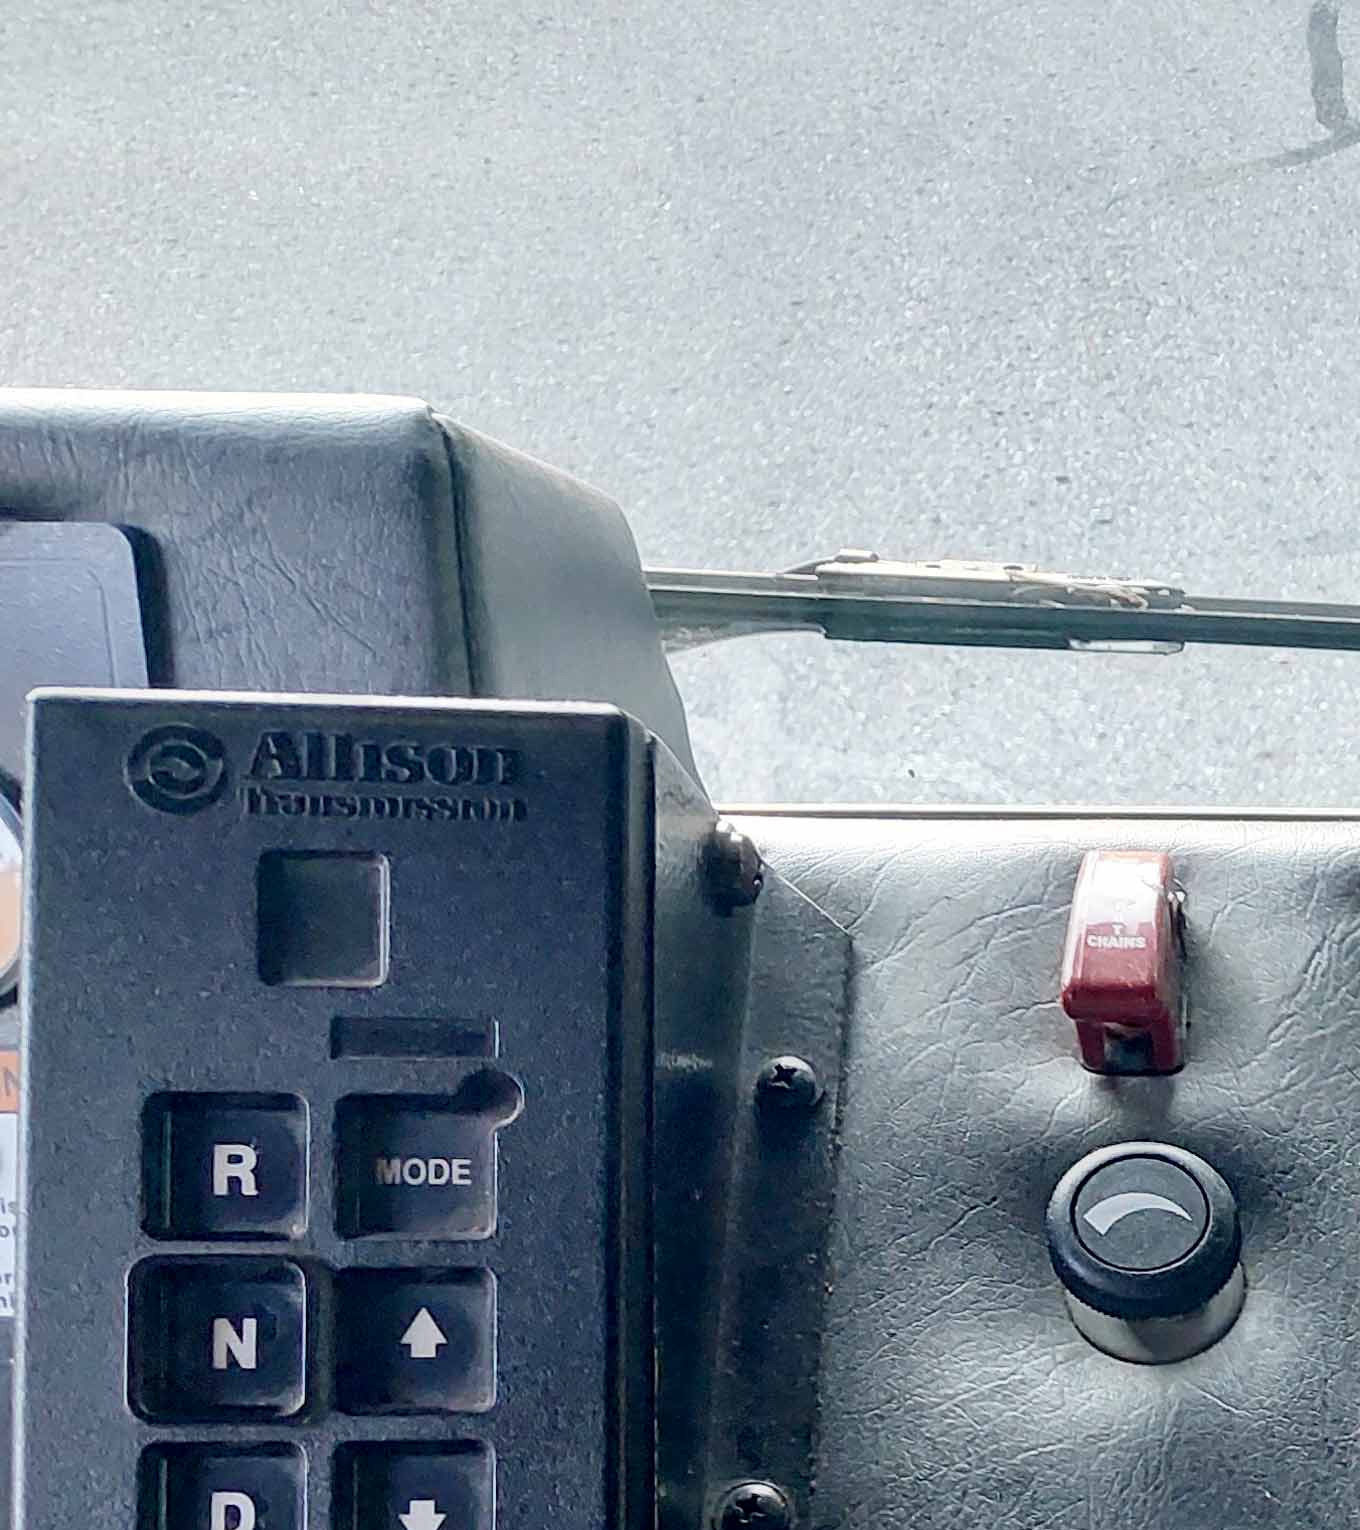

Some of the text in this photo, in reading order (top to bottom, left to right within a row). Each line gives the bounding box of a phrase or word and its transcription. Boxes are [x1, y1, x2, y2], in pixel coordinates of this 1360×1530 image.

[247, 730, 524, 786] Allison
[212, 1143, 258, 1197] R
[376, 1158, 472, 1186] MODE
[212, 1316, 257, 1370] N
